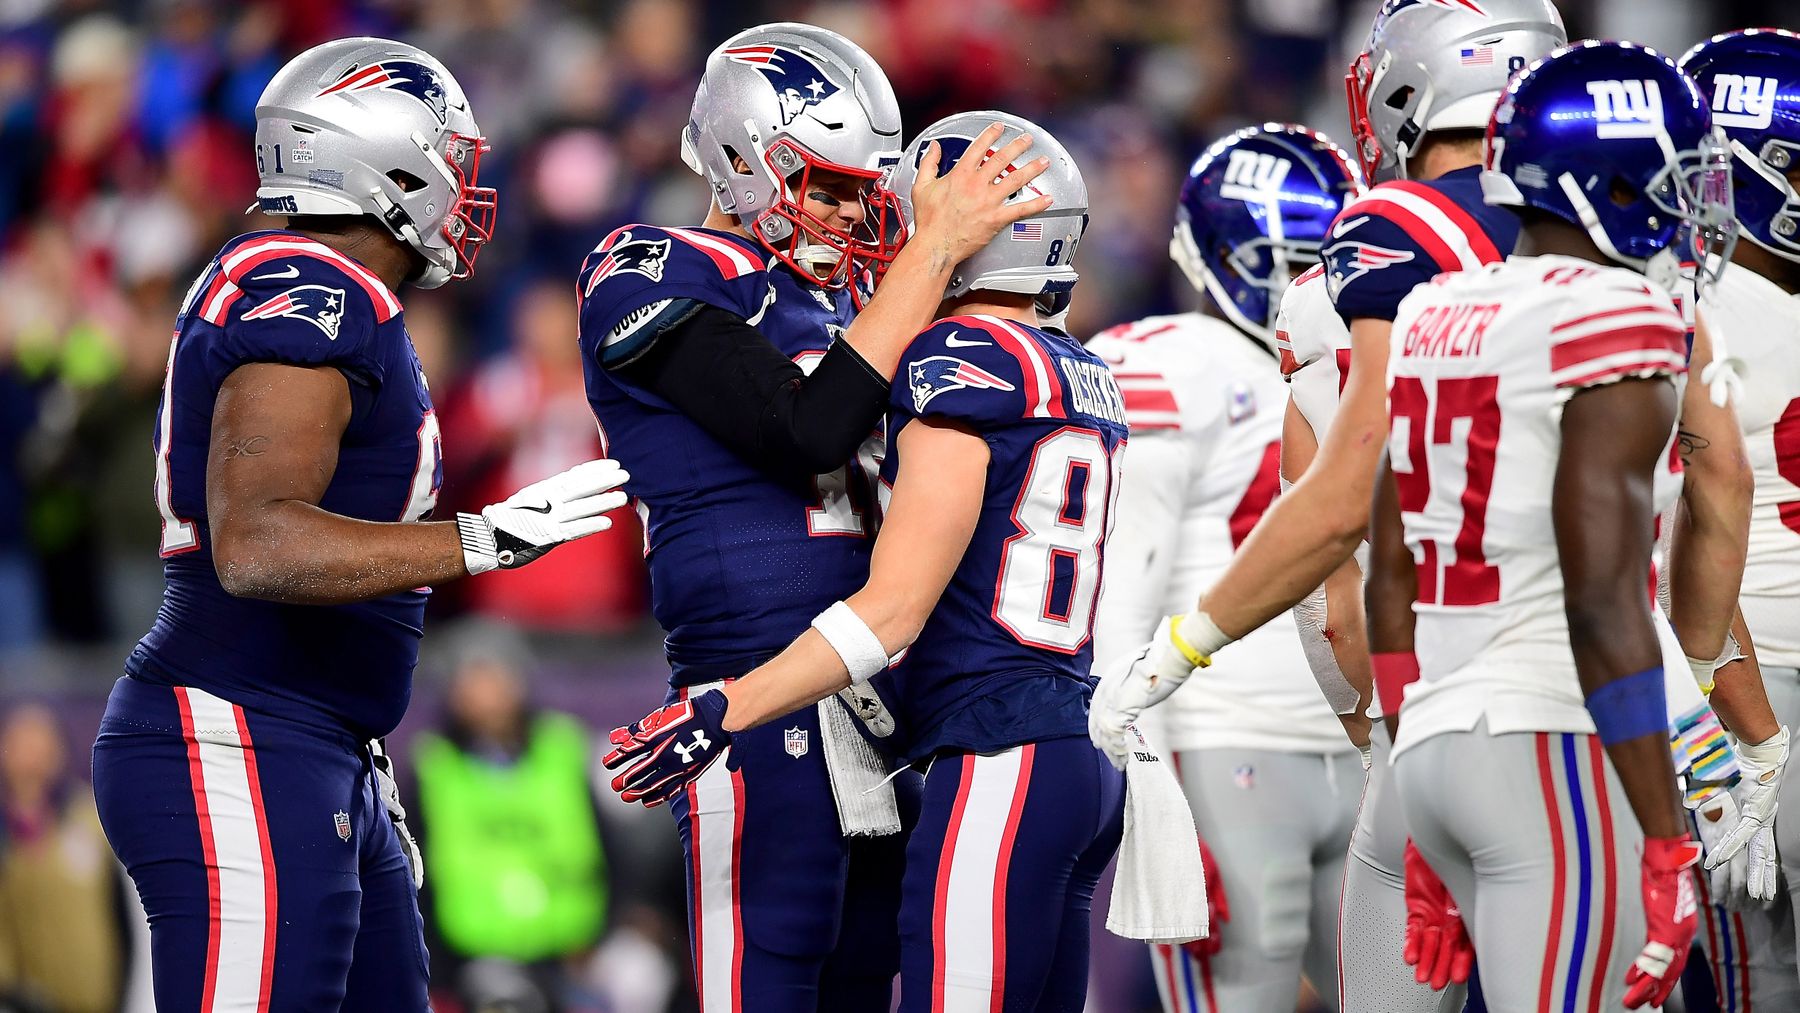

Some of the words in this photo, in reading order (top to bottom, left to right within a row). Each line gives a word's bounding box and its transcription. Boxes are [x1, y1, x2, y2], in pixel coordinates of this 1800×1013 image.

[1403, 303, 1502, 357] BAKER
[1390, 375, 1502, 607] 27
[1133, 751, 1159, 763] Wilso
